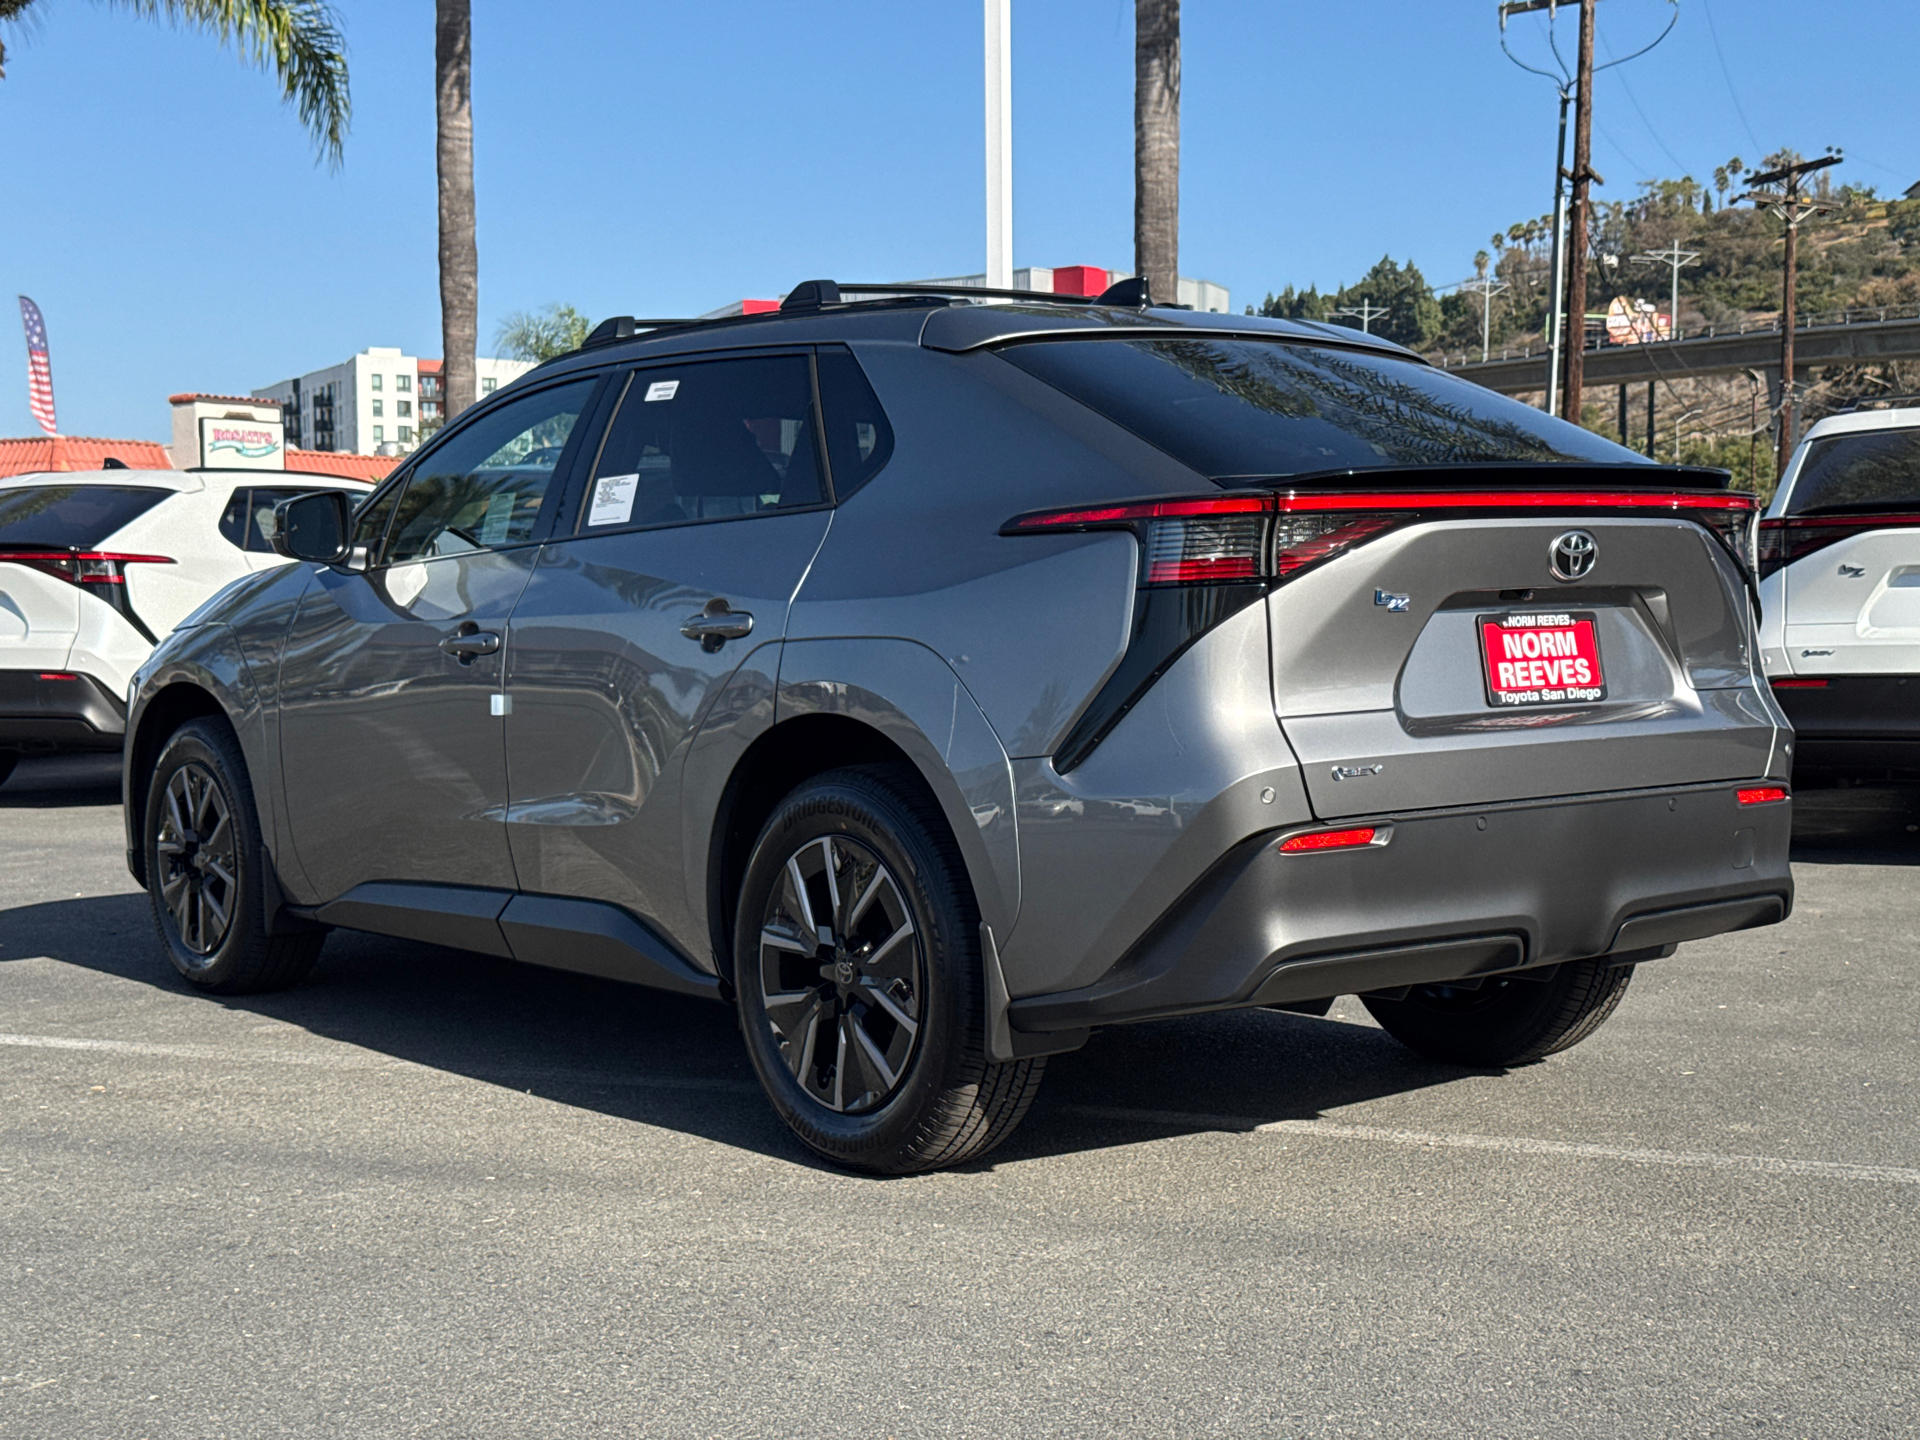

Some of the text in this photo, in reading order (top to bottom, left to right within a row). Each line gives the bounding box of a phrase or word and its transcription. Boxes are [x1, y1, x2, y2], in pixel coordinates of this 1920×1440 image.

[1508, 614, 1570, 628] NORM REEVES
[1502, 631, 1579, 659] NORM
[1498, 658, 1592, 688] REEVES
[1498, 687, 1602, 705] Toyota San Diego
[780, 794, 882, 837] BRIDGESTONE
